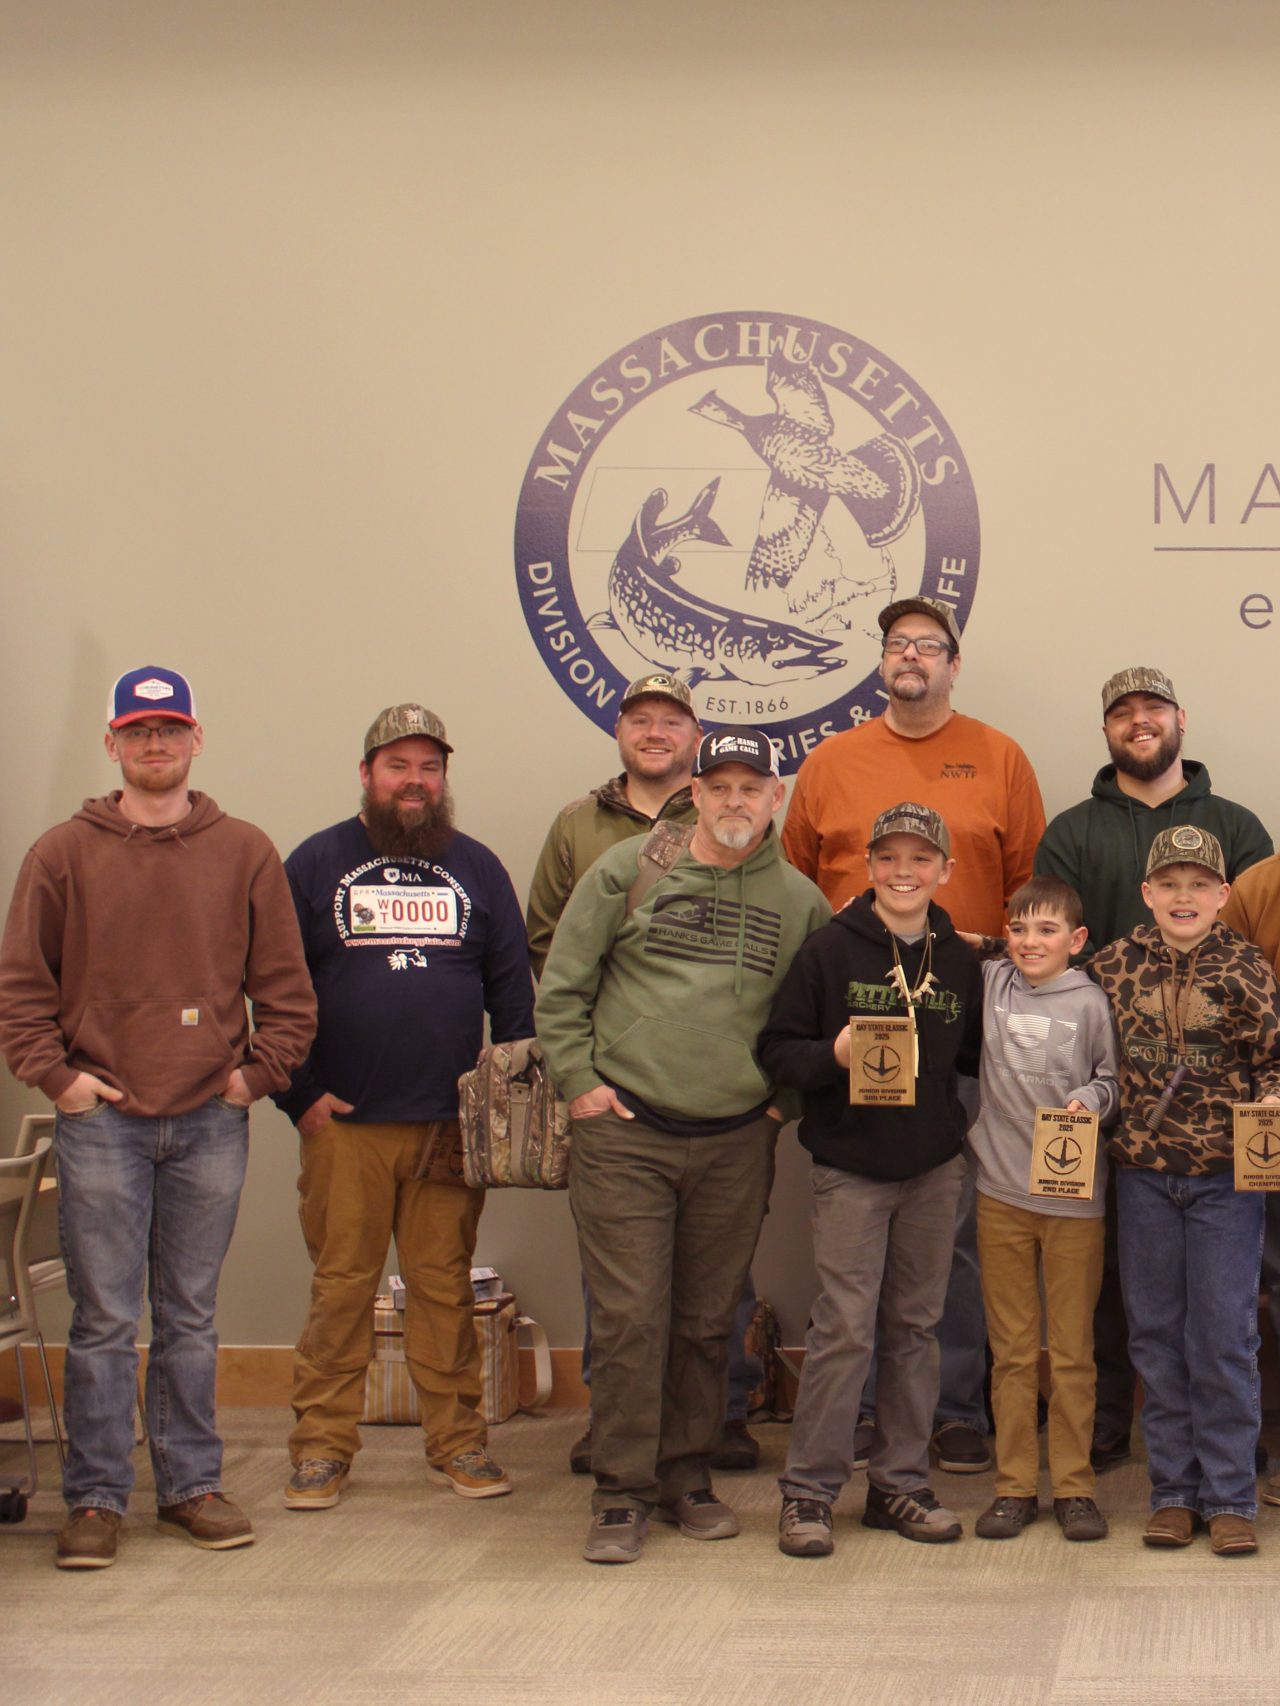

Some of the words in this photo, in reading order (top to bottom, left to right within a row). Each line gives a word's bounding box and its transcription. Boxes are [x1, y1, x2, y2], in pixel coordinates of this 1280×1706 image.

[534, 322, 959, 490] MASSACHUSETTS
[528, 561, 616, 709] DIVISION
[720, 745, 738, 753] GAME
[740, 745, 759, 755] CALLS
[375, 889, 430, 897] Massachusetts
[333, 888, 350, 939] SUPPORT
[432, 865, 472, 939] CONSERVATION
[658, 928, 698, 943] HANKS
[701, 937, 733, 948] GAME
[856, 1024, 867, 1032] BAY
[885, 1024, 908, 1032] CLASSIC
[1041, 1113, 1052, 1121] BAY
[1053, 1114, 1069, 1123] STATE
[1070, 1116, 1092, 1124] CLASSIC
